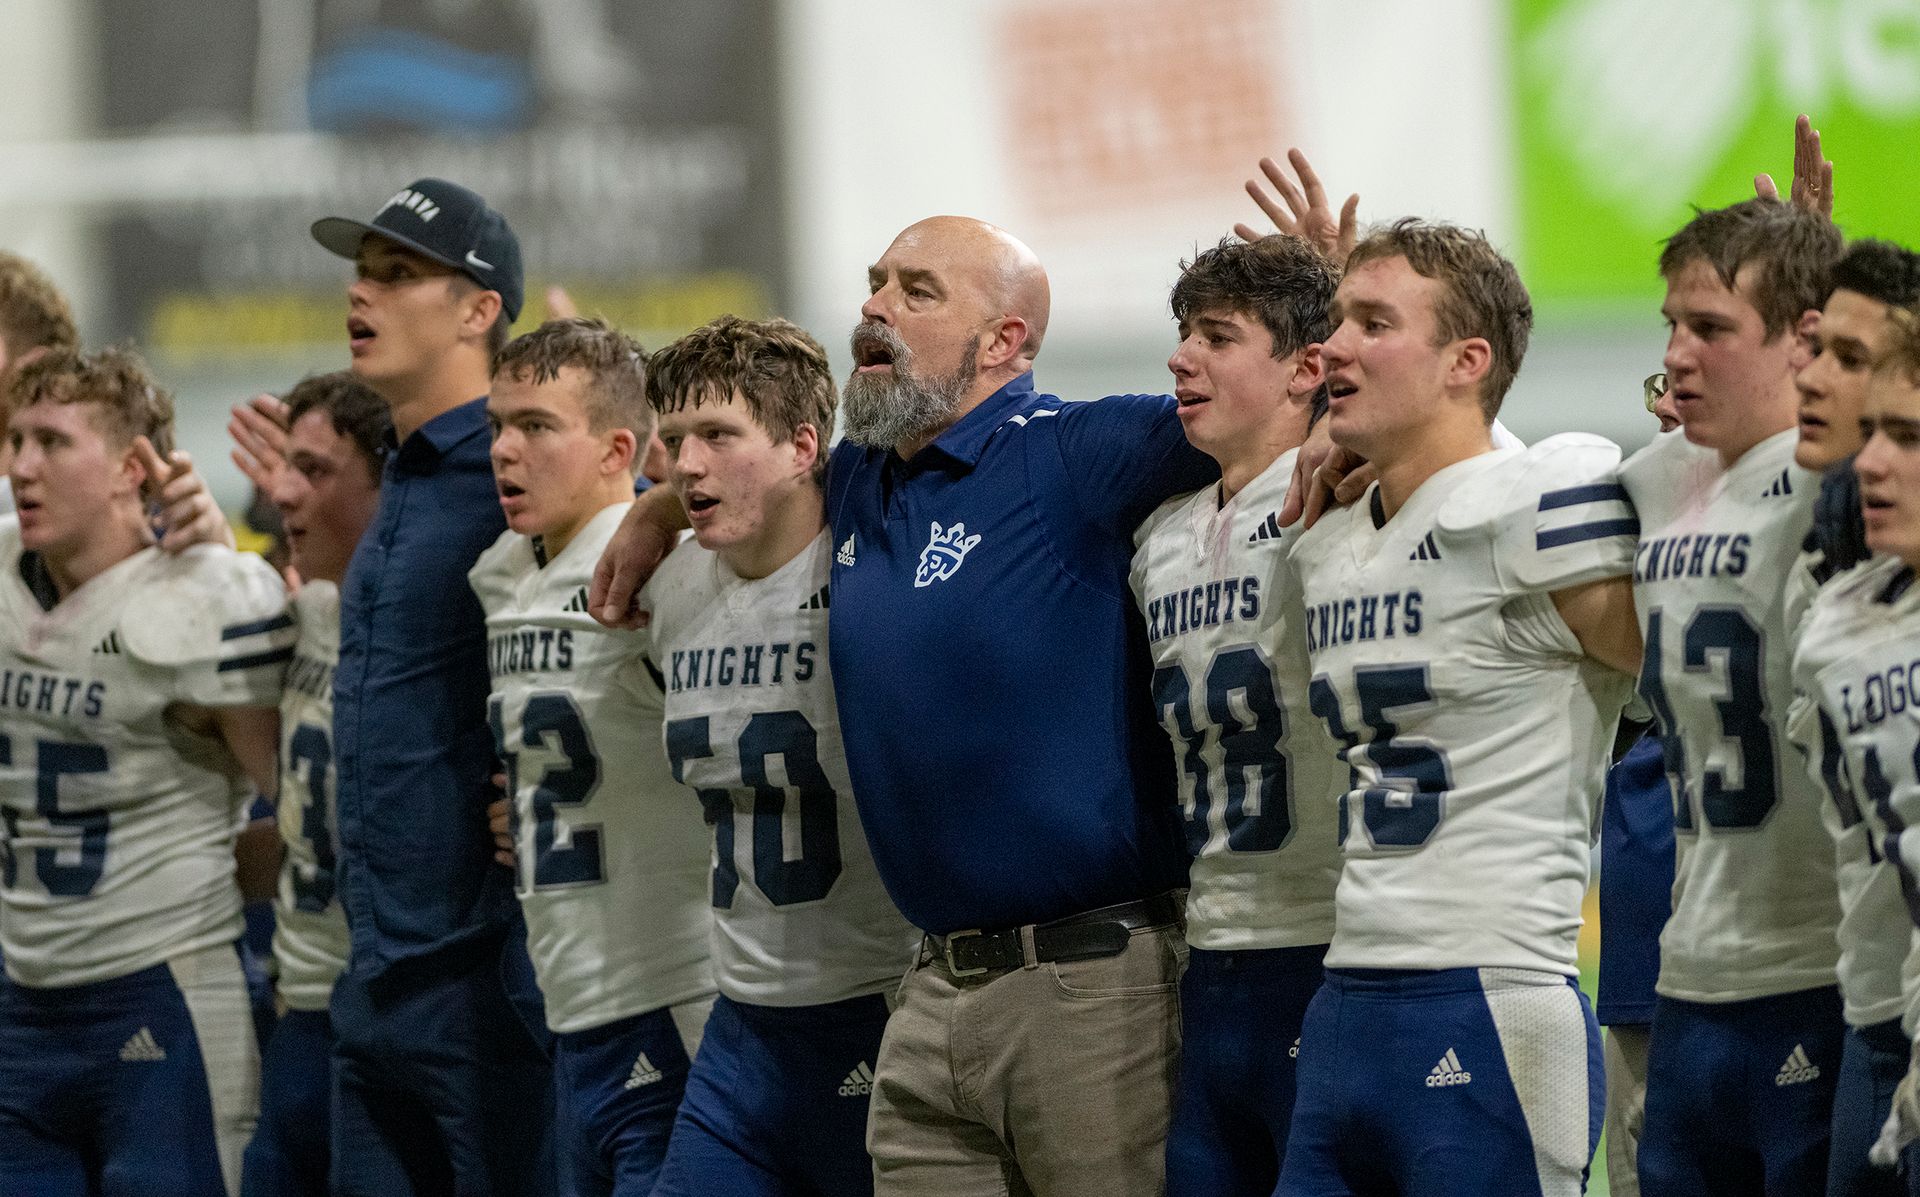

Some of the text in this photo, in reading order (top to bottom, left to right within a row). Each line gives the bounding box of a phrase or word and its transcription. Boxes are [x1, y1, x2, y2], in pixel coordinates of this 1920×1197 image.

[1148, 576, 1260, 645] KNIGHTS
[1306, 587, 1423, 655] KNIGHTS
[671, 642, 817, 692] KNIGHTS
[0, 732, 110, 897] 5
[666, 710, 843, 909] 50
[1425, 1071, 1471, 1087] adidas
